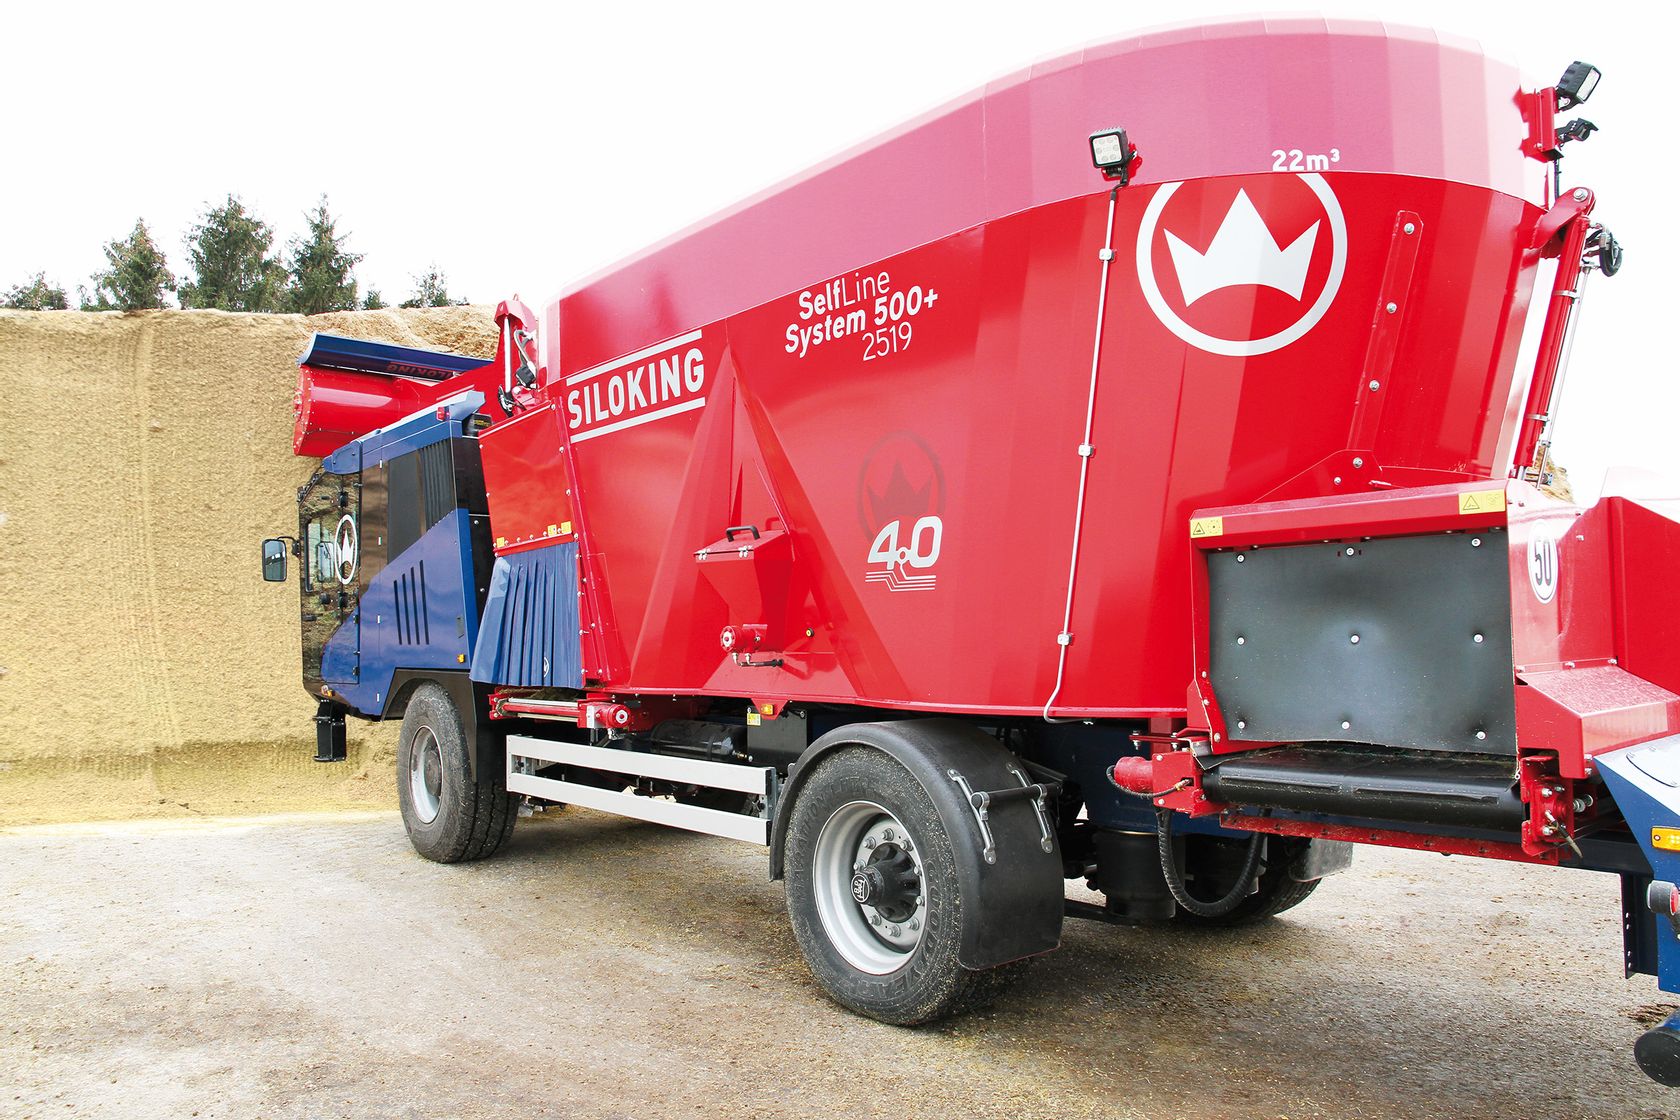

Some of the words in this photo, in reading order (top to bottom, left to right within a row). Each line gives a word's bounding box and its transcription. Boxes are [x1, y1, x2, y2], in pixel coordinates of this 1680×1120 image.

[799, 271, 890, 320] SelfLine
[785, 304, 866, 358] System
[874, 285, 939, 327] 500+
[862, 321, 913, 361] 2519
[568, 347, 705, 430] SILOKING
[1534, 536, 1552, 586] 50
